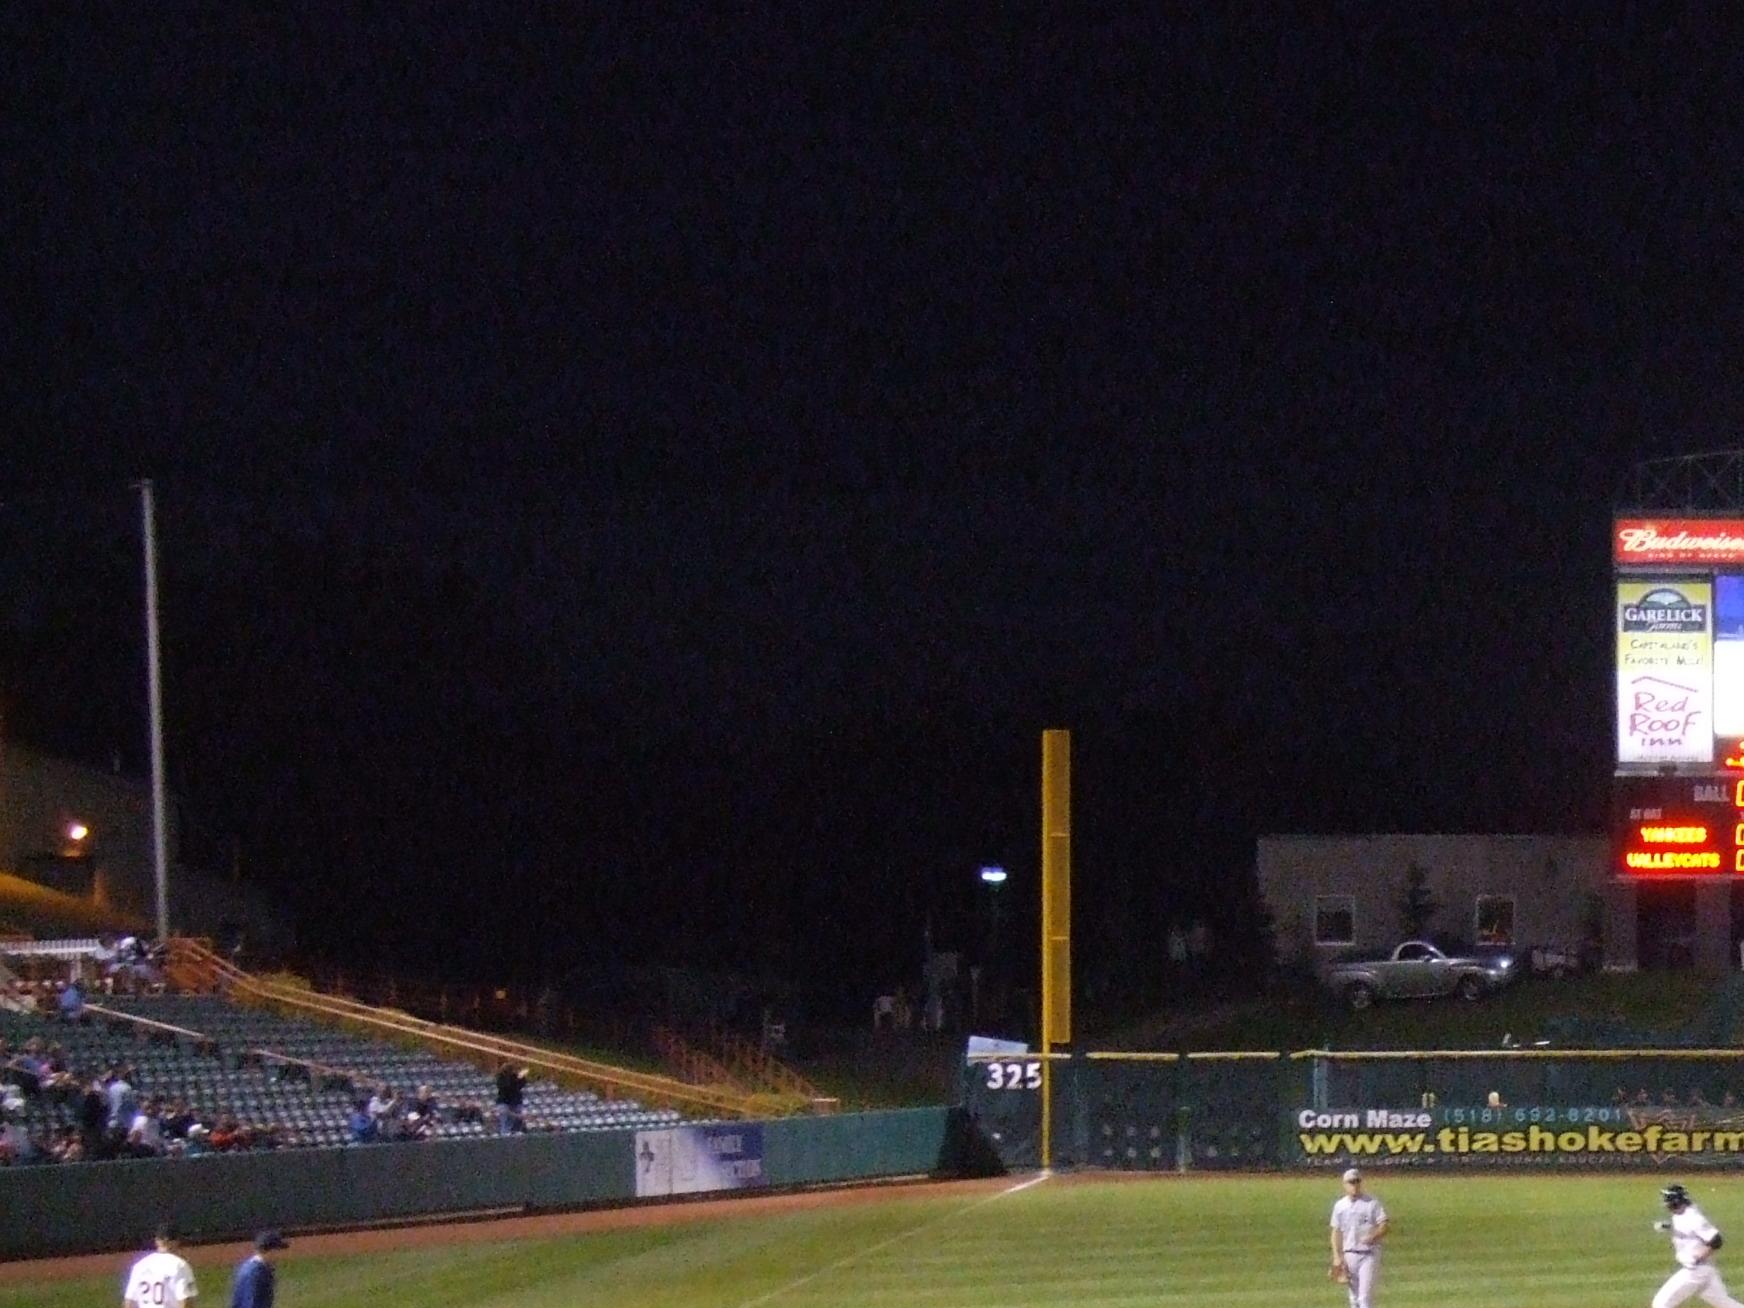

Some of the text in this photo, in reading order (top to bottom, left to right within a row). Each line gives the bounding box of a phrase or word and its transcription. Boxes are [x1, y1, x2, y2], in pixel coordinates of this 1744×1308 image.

[1625, 608, 1703, 623] GARELICK
[1634, 691, 1689, 712] Red
[1629, 710, 1702, 736] Roof
[1641, 737, 1683, 747] inn
[986, 1062, 1043, 1090] 325
[1299, 1109, 1433, 1129] Corn Maze
[1444, 1107, 1502, 1123] (518)
[138, 1281, 165, 1305] 20
